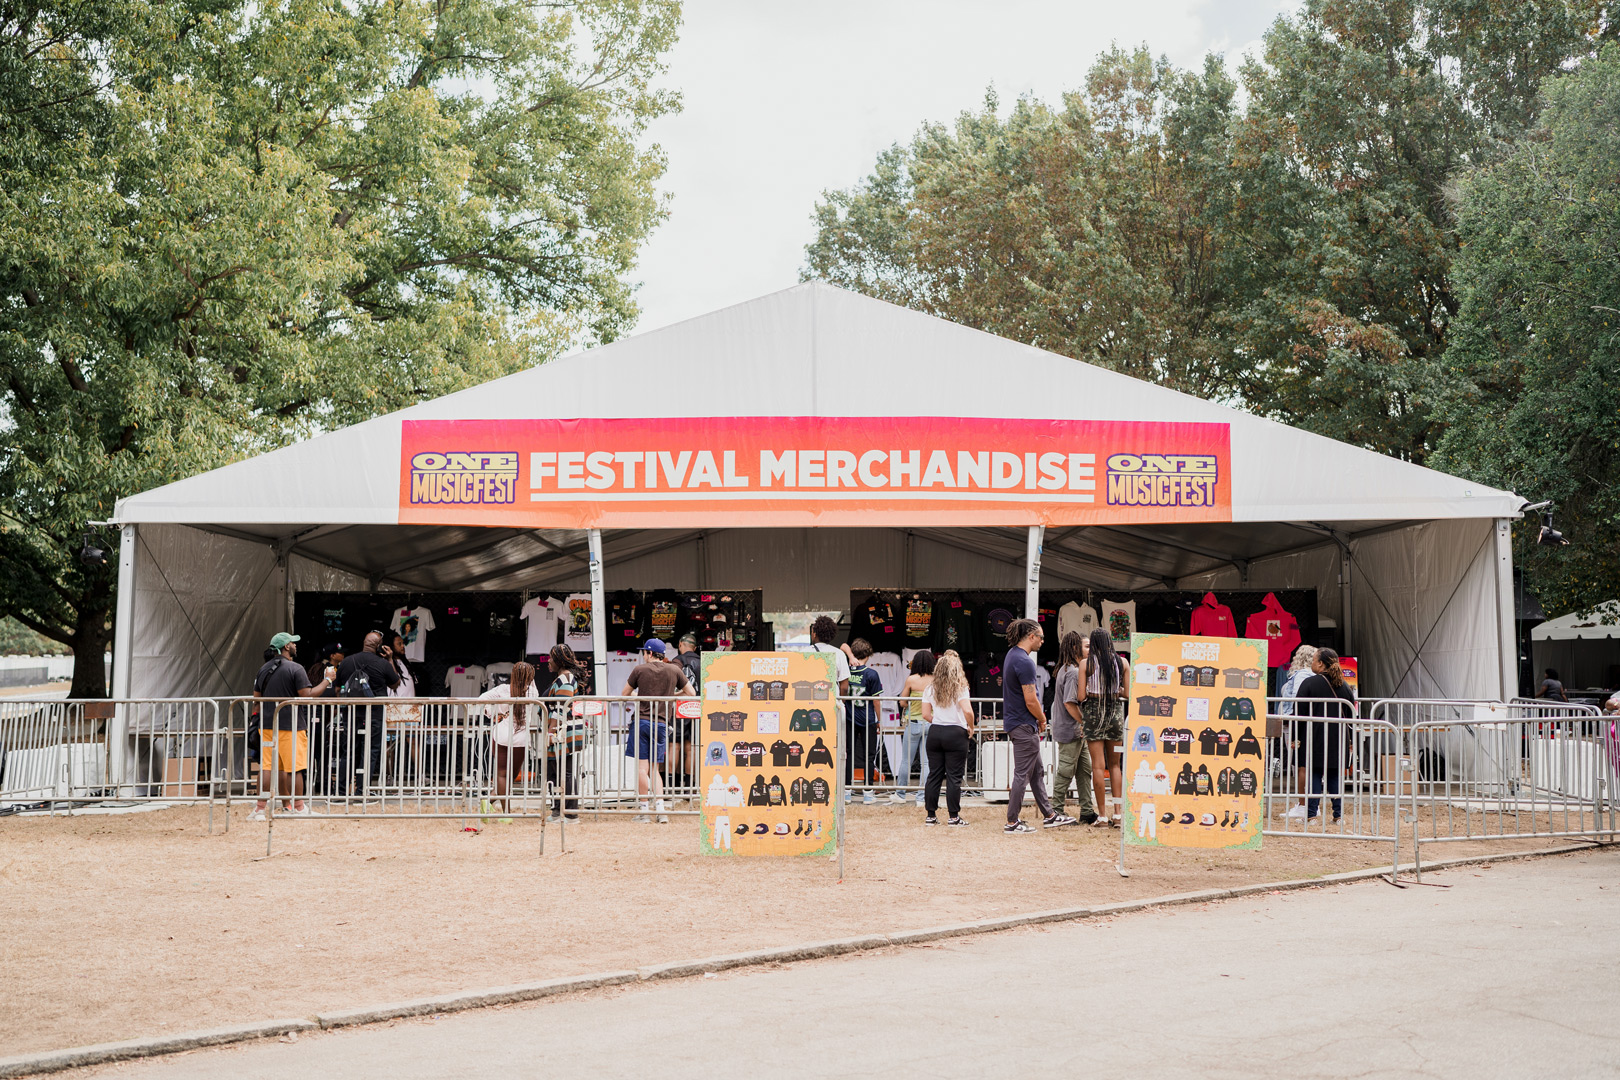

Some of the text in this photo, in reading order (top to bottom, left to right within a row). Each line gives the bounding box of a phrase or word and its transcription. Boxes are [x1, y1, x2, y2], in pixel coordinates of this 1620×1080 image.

[412, 453, 518, 470] ONE
[530, 449, 1097, 491] FESTIVAL MERCHANDISE
[1108, 454, 1217, 473] ONE
[412, 473, 517, 503] MUSICFEST
[1108, 475, 1216, 506] MUSICFEST
[1181, 648, 1220, 661] MUSICFEST
[750, 663, 789, 676] MUSICFEST
